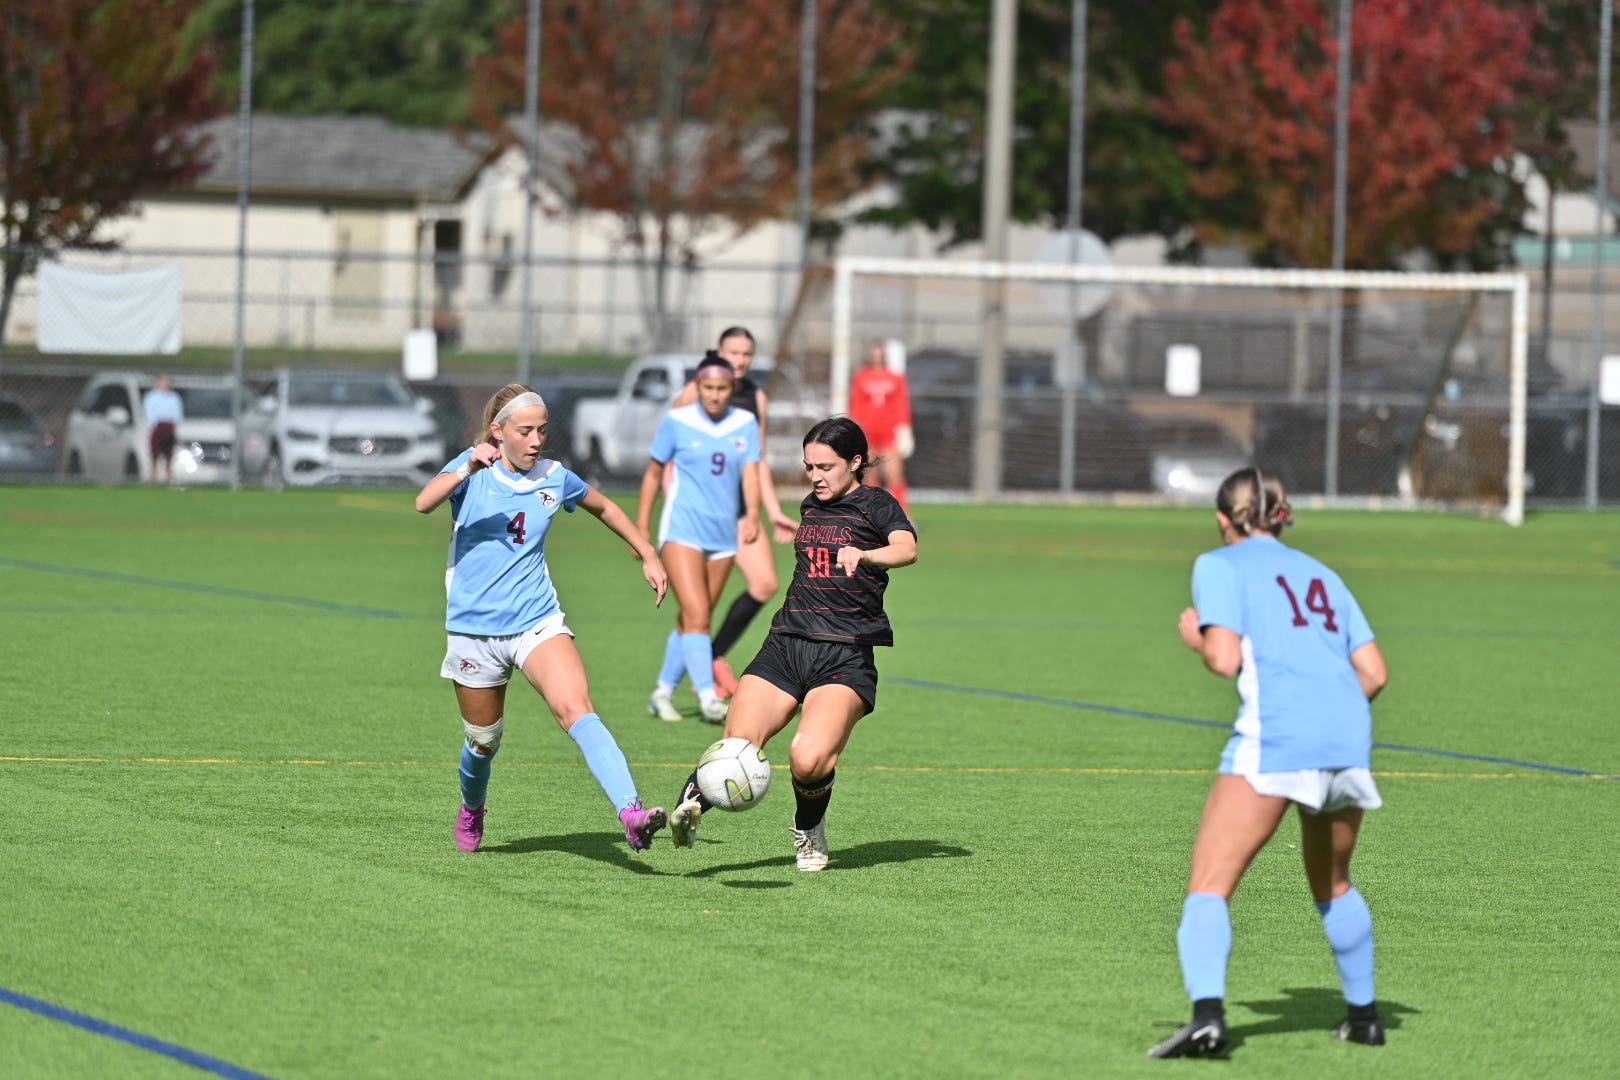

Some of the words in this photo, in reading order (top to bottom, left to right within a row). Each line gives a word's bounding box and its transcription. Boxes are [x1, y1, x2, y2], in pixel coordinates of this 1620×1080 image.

[711, 452, 726, 476] 9
[507, 511, 526, 544] 4
[795, 525, 853, 546] DEVILS
[1276, 575, 1338, 632] 14
